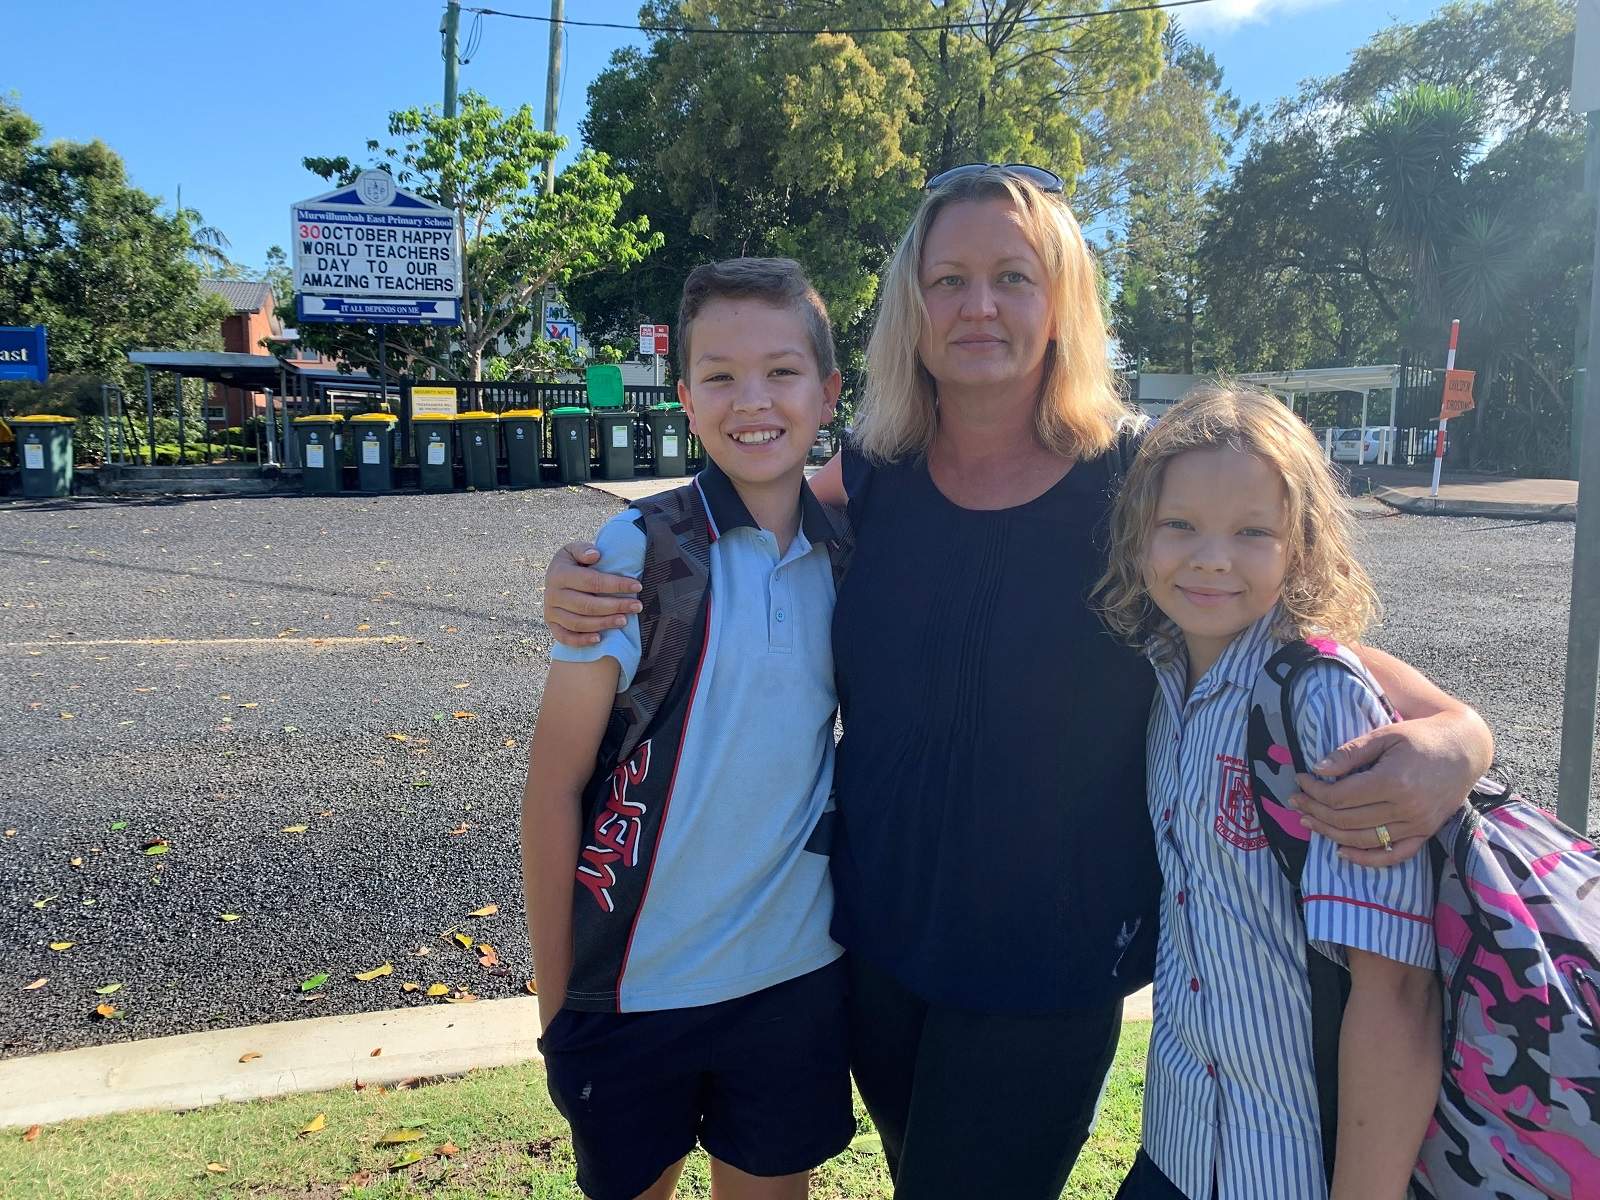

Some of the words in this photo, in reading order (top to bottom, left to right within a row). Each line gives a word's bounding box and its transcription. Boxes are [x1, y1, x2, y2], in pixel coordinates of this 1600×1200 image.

[299, 210, 365, 223] Murwillumbah
[366, 215, 387, 224] East
[388, 216, 423, 227] Primary
[424, 217, 453, 228] School
[299, 224, 320, 239] 30
[321, 226, 397, 243] OCTOBER
[402, 230, 452, 245] HAPPY
[302, 241, 358, 257] WORLD
[365, 244, 450, 261] TEACHERS
[318, 257, 350, 271] DAY
[367, 260, 388, 273] TO
[406, 261, 437, 276] OUR
[302, 273, 369, 288] AMAZING
[373, 276, 454, 292] TEACHERS
[341, 303, 350, 313] IT
[350, 304, 364, 313] ALL
[365, 304, 396, 314] DEPENDS
[397, 305, 407, 314] ON
[408, 306, 420, 315] ME
[0, 348, 29, 361] ast
